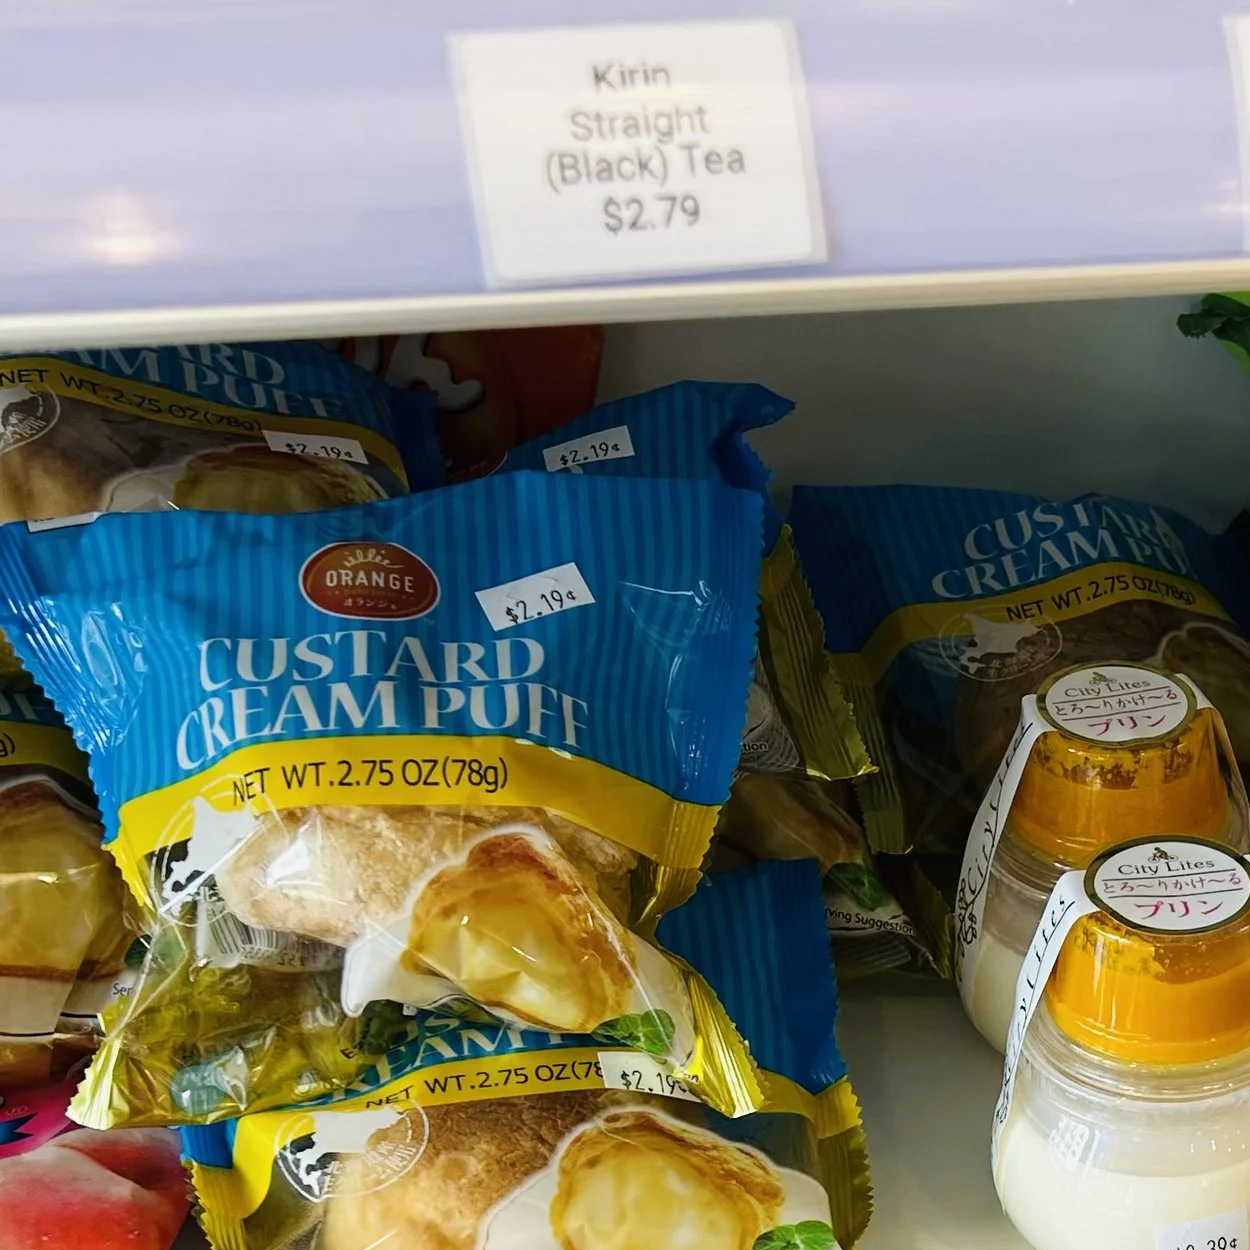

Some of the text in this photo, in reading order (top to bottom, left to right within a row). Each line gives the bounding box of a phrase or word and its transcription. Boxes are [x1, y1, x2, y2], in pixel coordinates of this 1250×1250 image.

[591, 63, 672, 92] Kirin
[569, 104, 711, 143] Straight
[545, 143, 747, 193] (Black) Tea
[602, 194, 700, 235] $2.79
[932, 529, 1120, 599] CREAM
[325, 569, 416, 594] ORANGE
[1006, 600, 1046, 622] NET
[199, 629, 545, 691] CUSTARD
[1064, 679, 1152, 698] City Lites
[176, 680, 588, 770] CREAM PUFF
[1088, 714, 1166, 737] プリン
[233, 756, 508, 807] NET OZ(78g)
[1118, 858, 1215, 876] City Lites
[1134, 900, 1223, 919] プリン
[366, 1086, 413, 1110] NET
